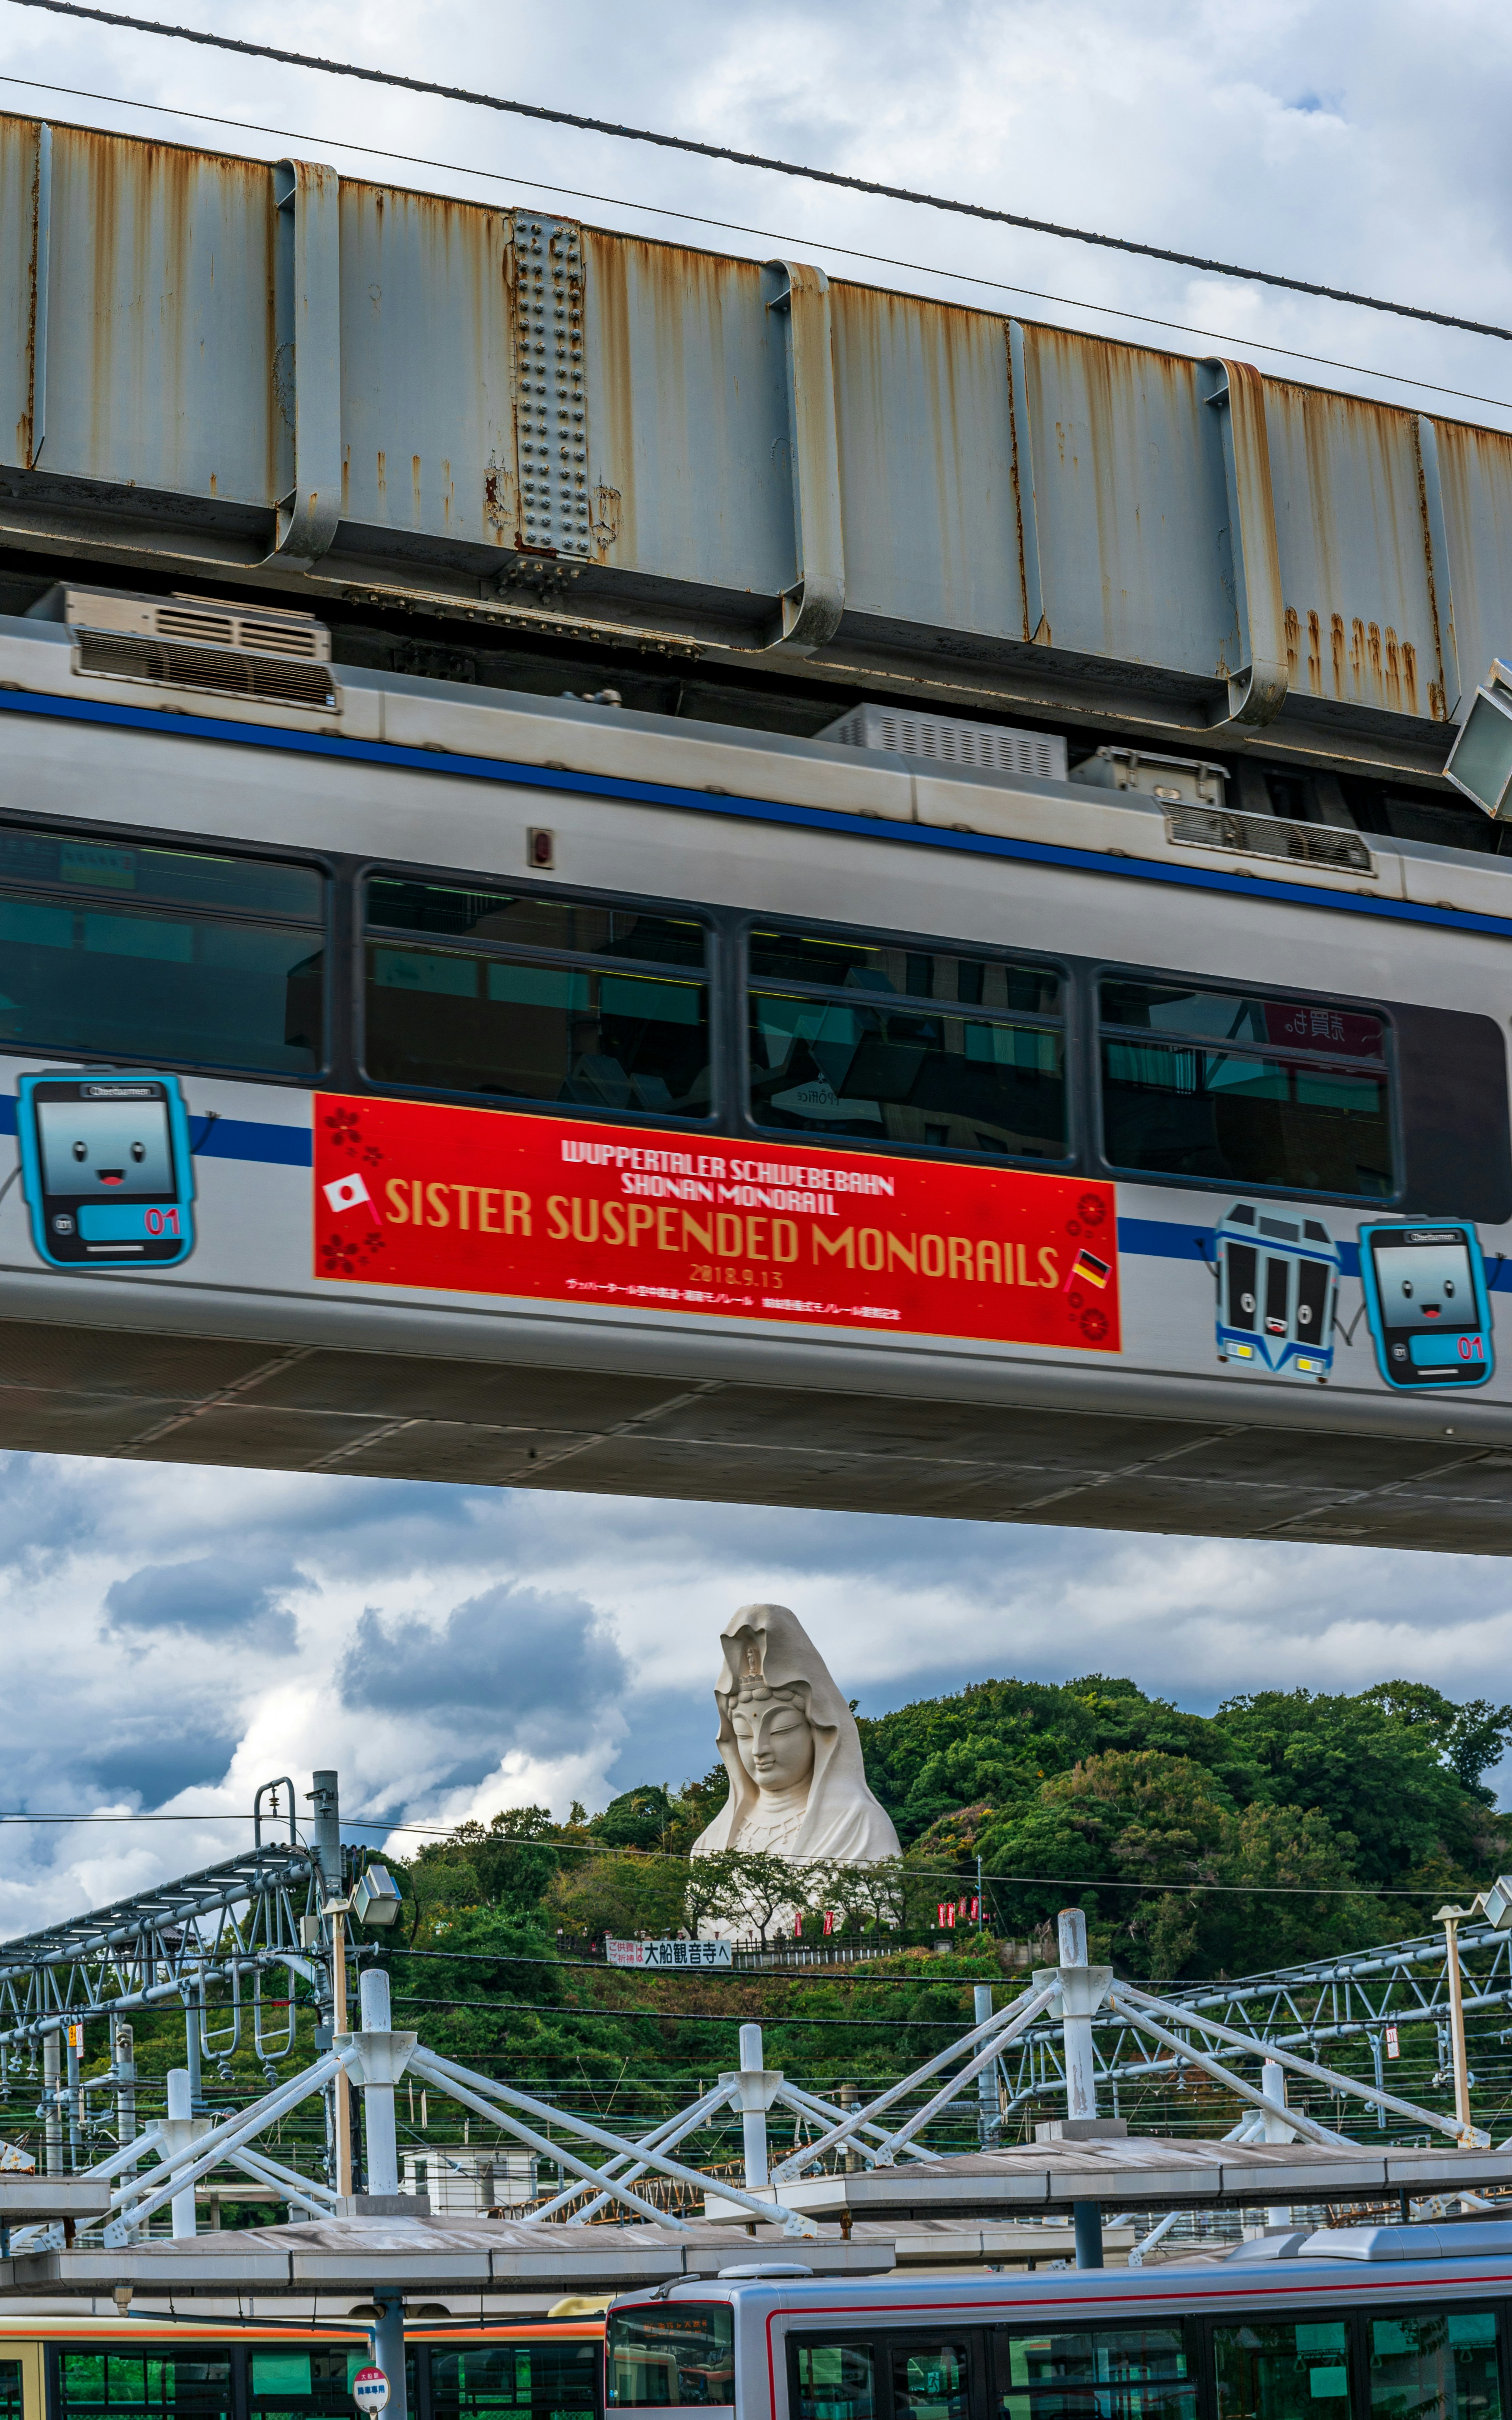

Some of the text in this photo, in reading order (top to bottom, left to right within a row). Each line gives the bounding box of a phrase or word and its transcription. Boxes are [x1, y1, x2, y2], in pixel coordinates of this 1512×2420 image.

[561, 1140, 895, 1197] WUPPERTALER SCHWEBEBAHN
[621, 1172, 840, 1216] SHONAN MONORAIL
[144, 1208, 180, 1235] 01
[385, 1178, 1060, 1289] SISTER SUSPENDED MONORAILS
[689, 1264, 783, 1289] 2018.9.13
[1457, 1337, 1484, 1360] 01
[609, 1941, 634, 1952] ご供養
[645, 1942, 729, 1964] 大船観音寺へ
[358, 2385, 385, 2395] 降車専用
